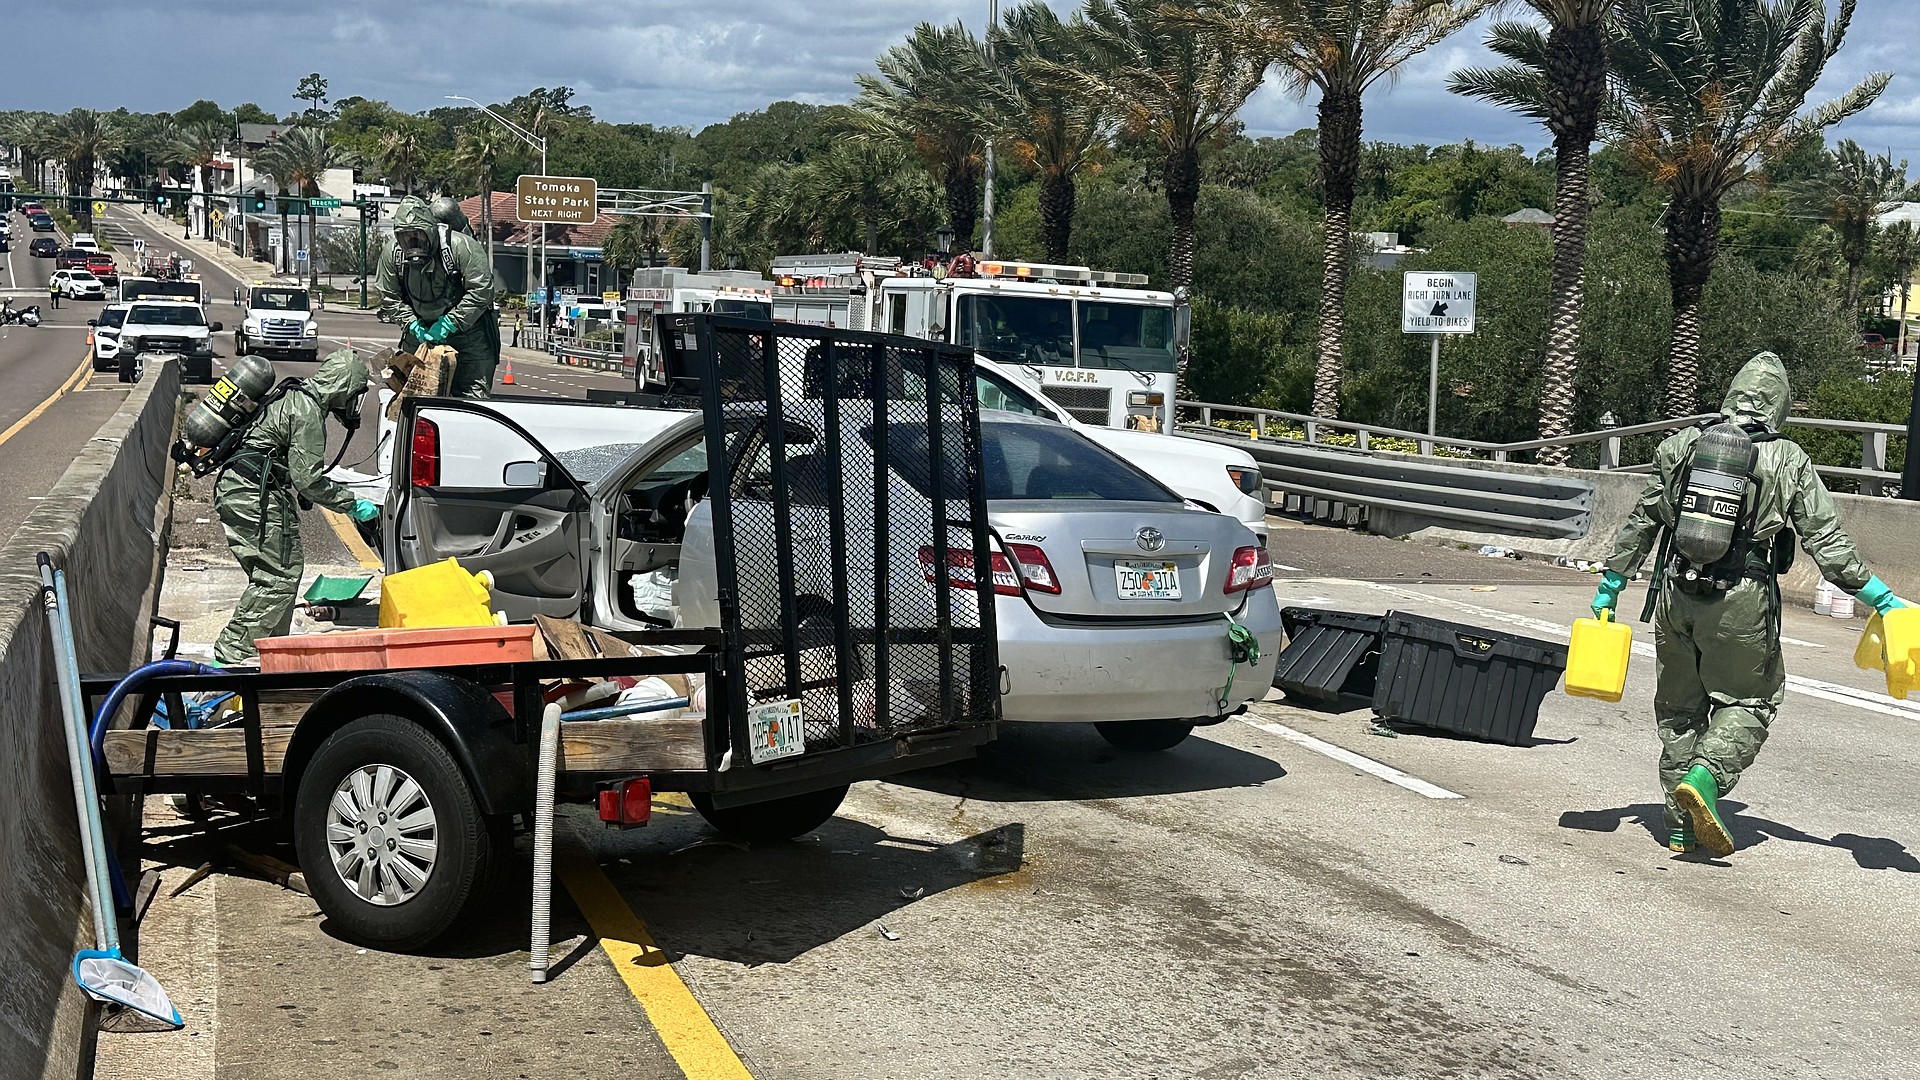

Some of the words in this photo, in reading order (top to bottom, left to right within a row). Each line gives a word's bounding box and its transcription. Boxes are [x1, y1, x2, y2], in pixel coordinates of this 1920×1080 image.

[535, 181, 580, 193] Tomoka
[524, 195, 557, 206] State
[562, 196, 590, 207] Park
[531, 209, 553, 218] NEXT
[557, 210, 582, 219] RIGHT
[1427, 278, 1454, 288] BEGIN
[1407, 290, 1428, 300] RIGHT
[1433, 290, 1451, 300] TURN
[1453, 290, 1472, 300] LANE
[1409, 317, 1431, 327] YIELD
[1434, 317, 1443, 327] TO
[1446, 317, 1468, 327] BIKES
[1055, 370, 1098, 384] V.C.F.R.
